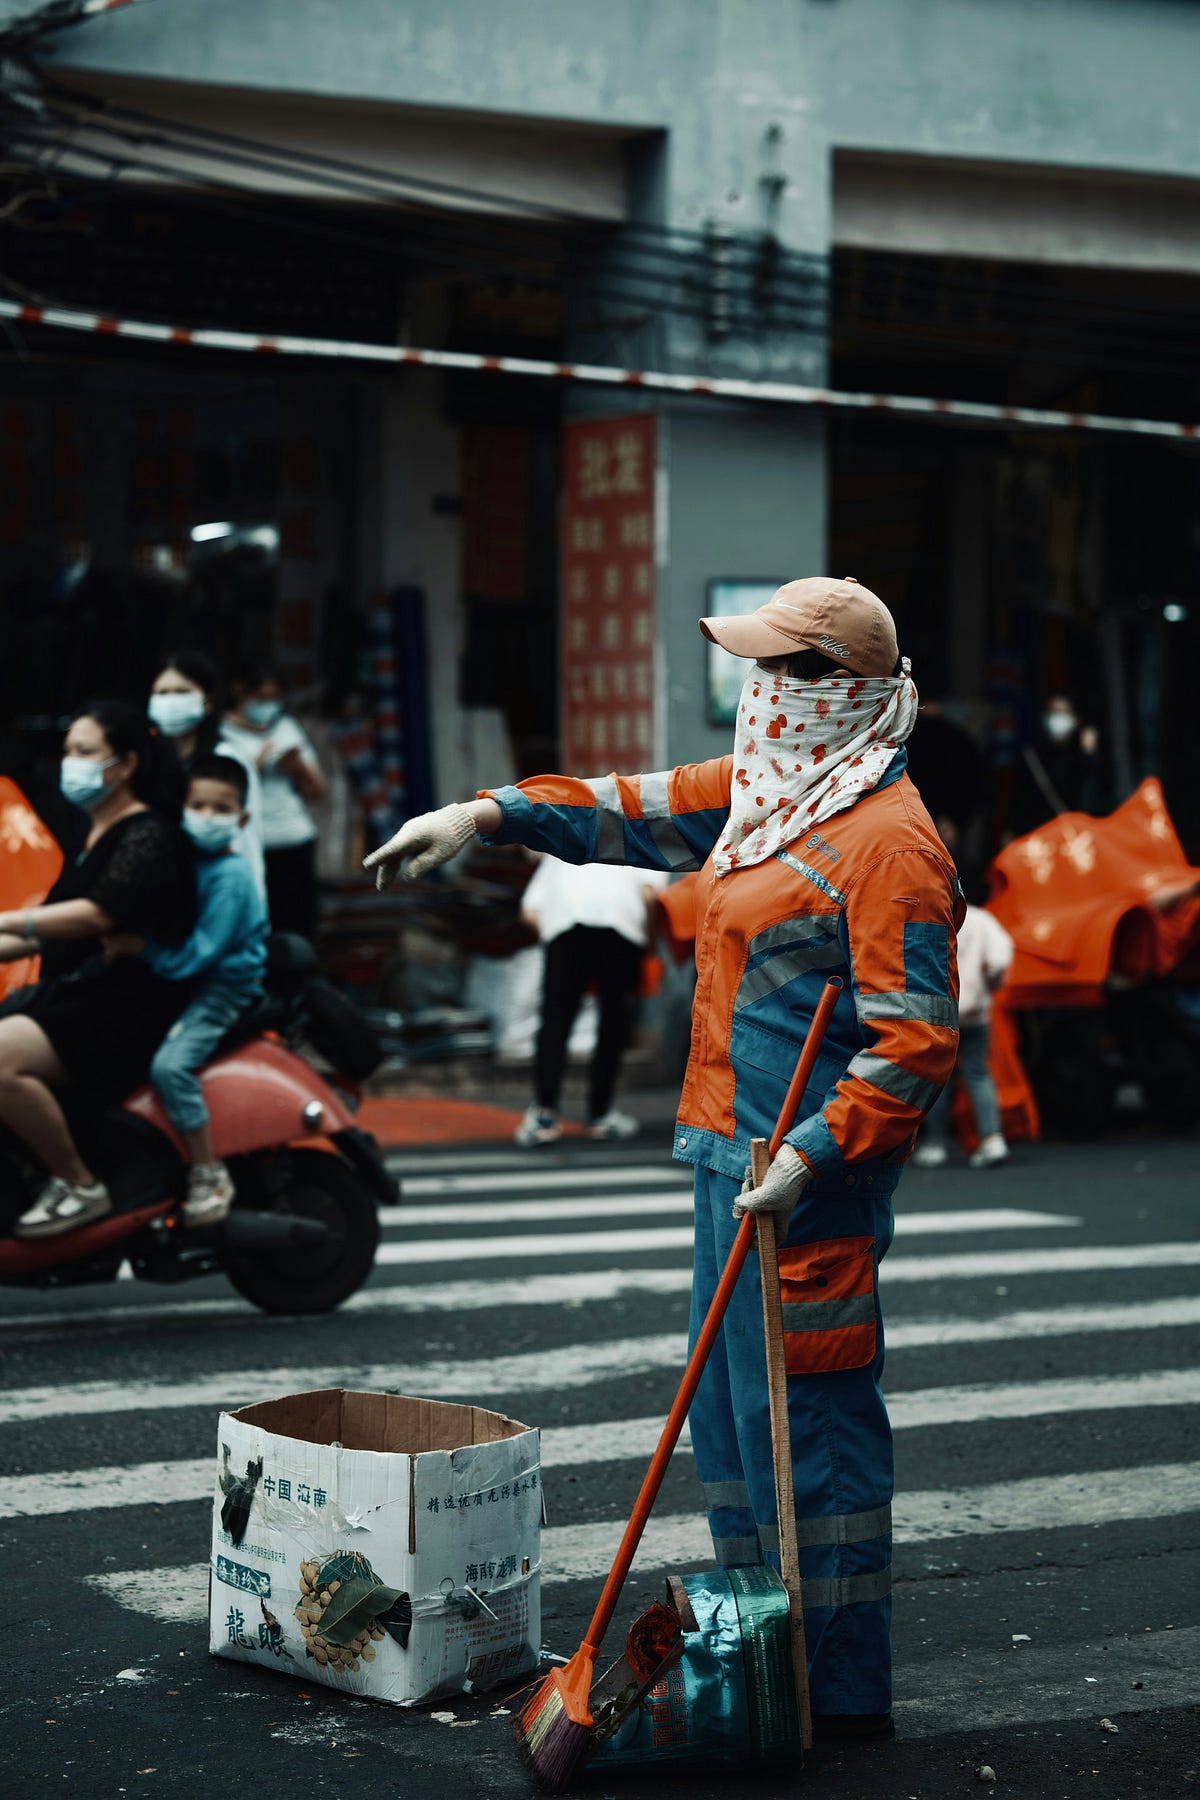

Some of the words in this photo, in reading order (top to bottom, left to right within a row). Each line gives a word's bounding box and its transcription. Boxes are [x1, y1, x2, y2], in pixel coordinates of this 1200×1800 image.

[818, 634, 852, 659] Nike
[263, 1475, 291, 1501] 中国
[297, 1482, 328, 1508] 海南
[427, 1474, 538, 1514] 精选优质无污染水果
